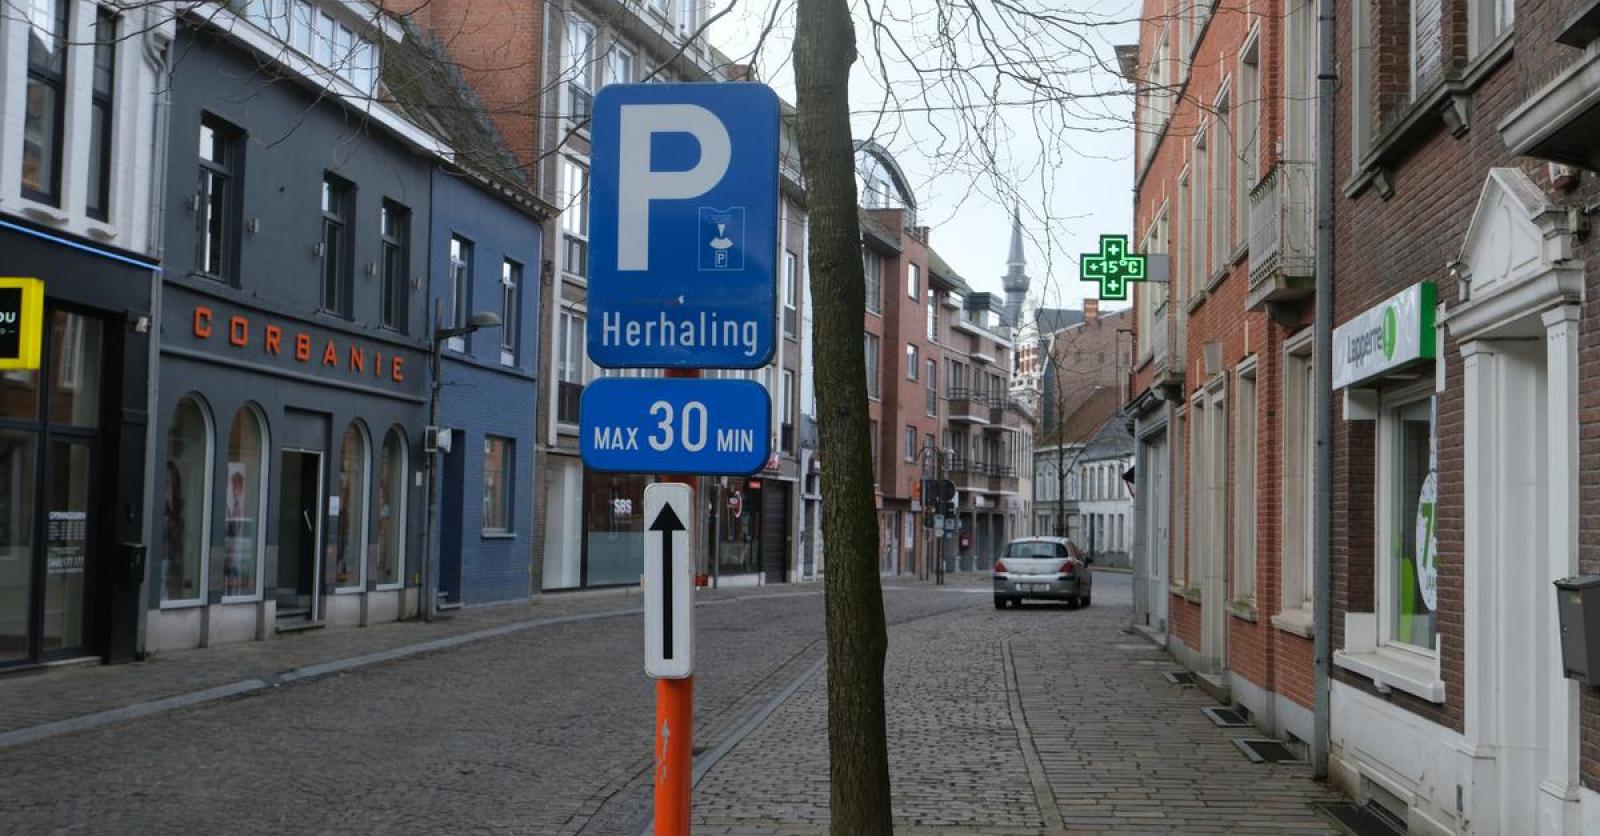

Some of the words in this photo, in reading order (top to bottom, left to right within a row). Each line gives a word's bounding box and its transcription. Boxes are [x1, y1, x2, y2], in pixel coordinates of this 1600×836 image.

[617, 104, 732, 271] P
[194, 306, 405, 382] CORBANIE
[602, 311, 758, 356] Herhaling
[594, 427, 639, 450] MAX
[649, 400, 708, 451] 30
[717, 429, 753, 452] MIN
